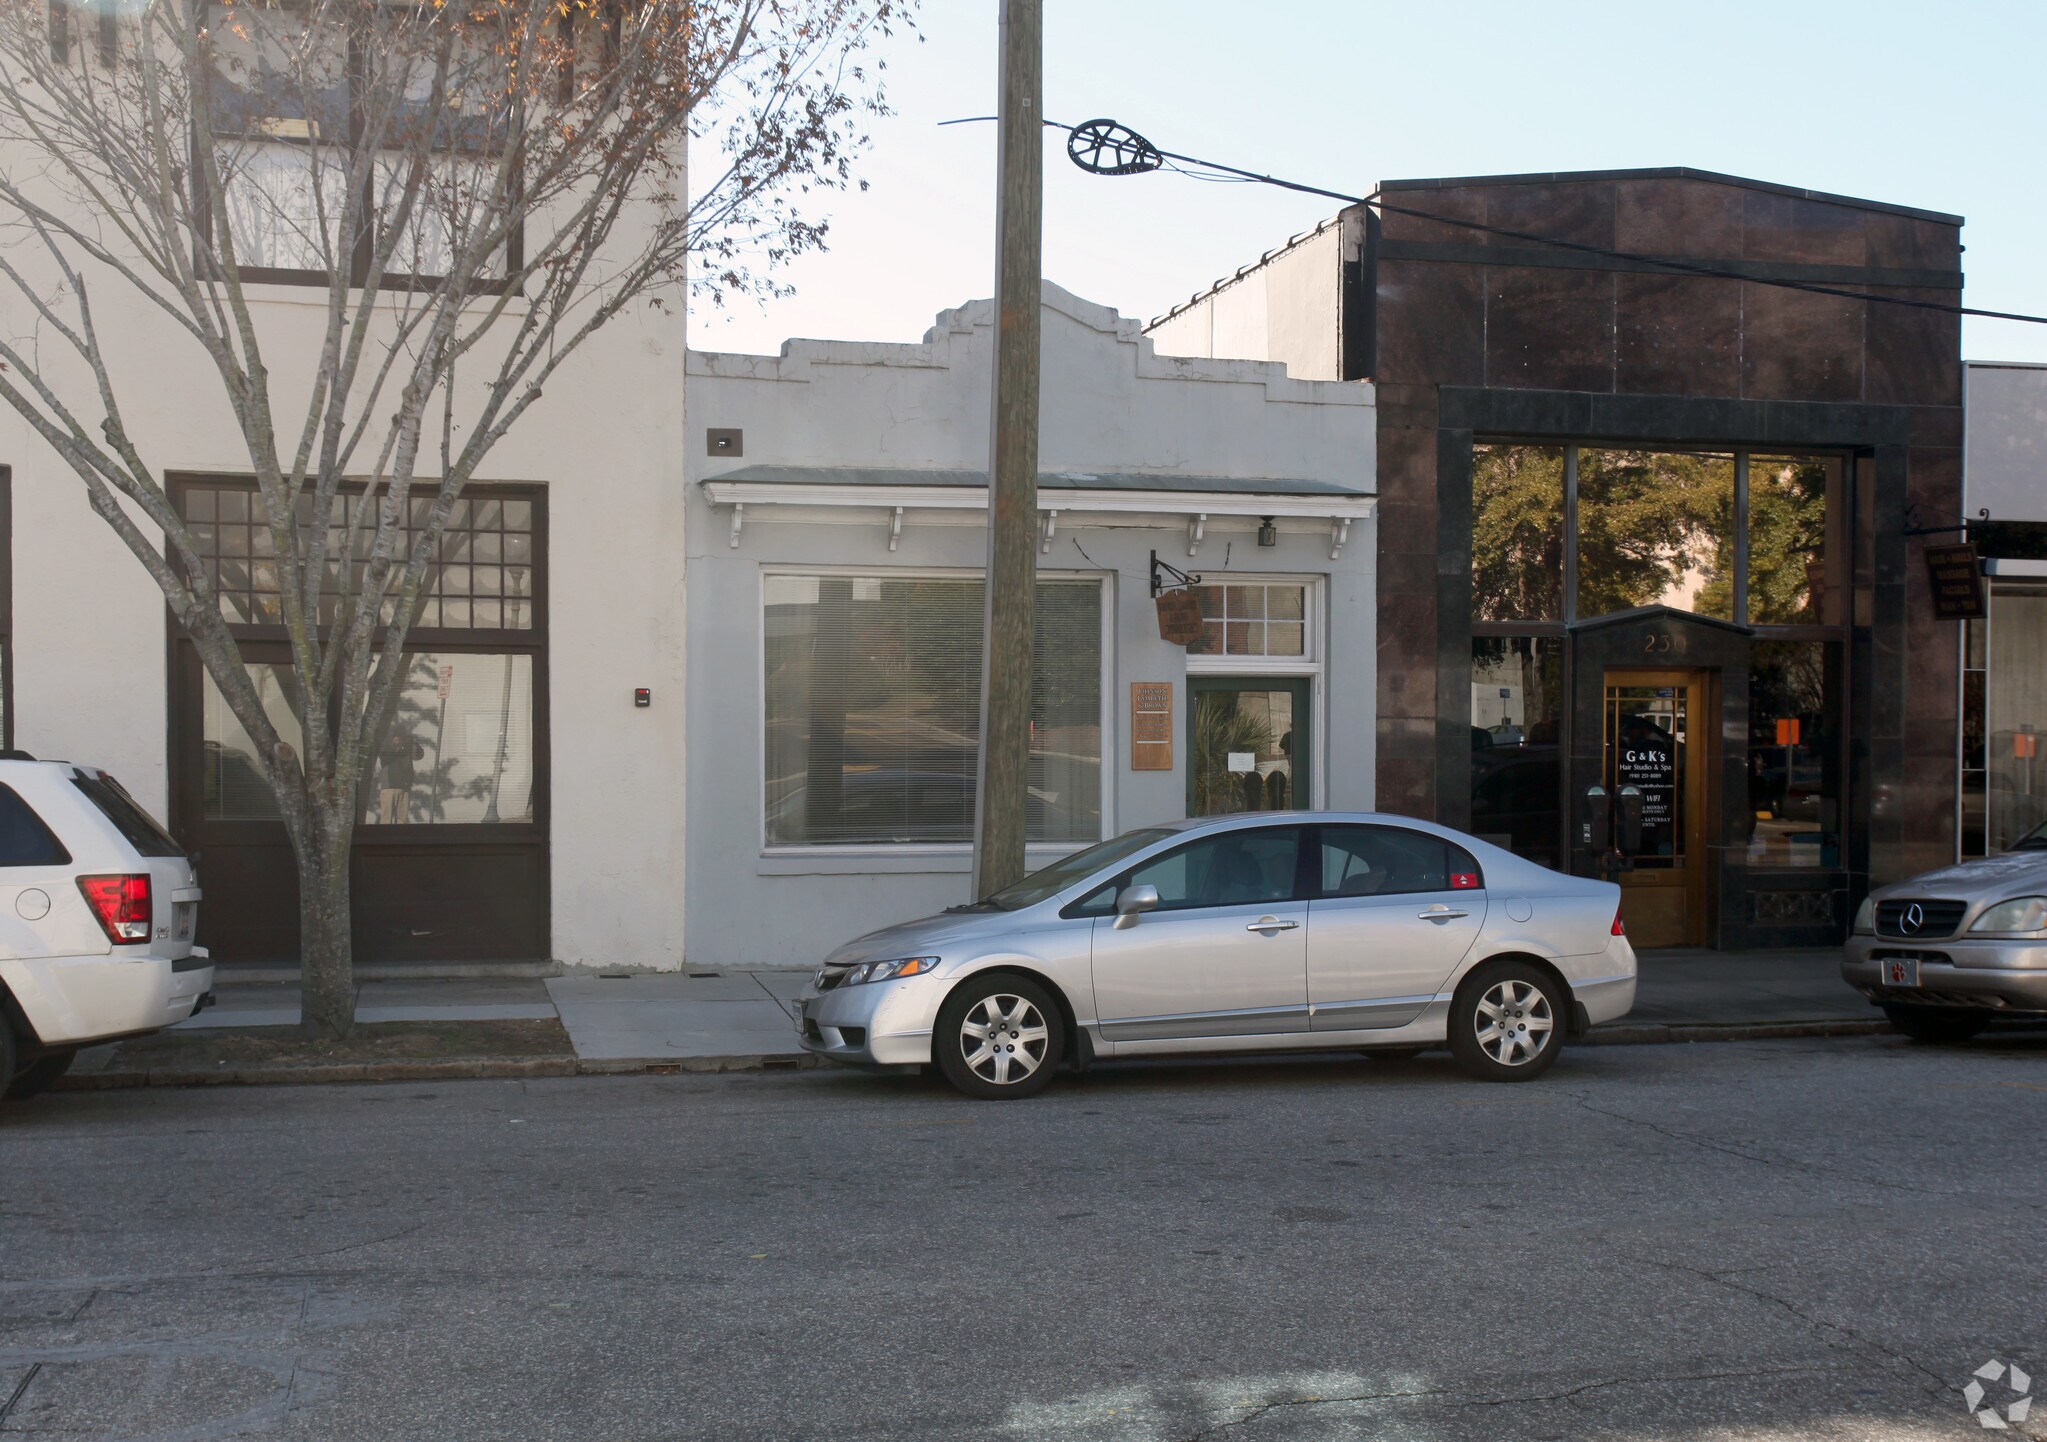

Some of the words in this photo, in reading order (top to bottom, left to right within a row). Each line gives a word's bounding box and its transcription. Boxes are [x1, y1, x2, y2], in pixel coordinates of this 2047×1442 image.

[1626, 750, 1636, 762] G
[1639, 752, 1646, 761] &
[1648, 750, 1666, 762] K's
